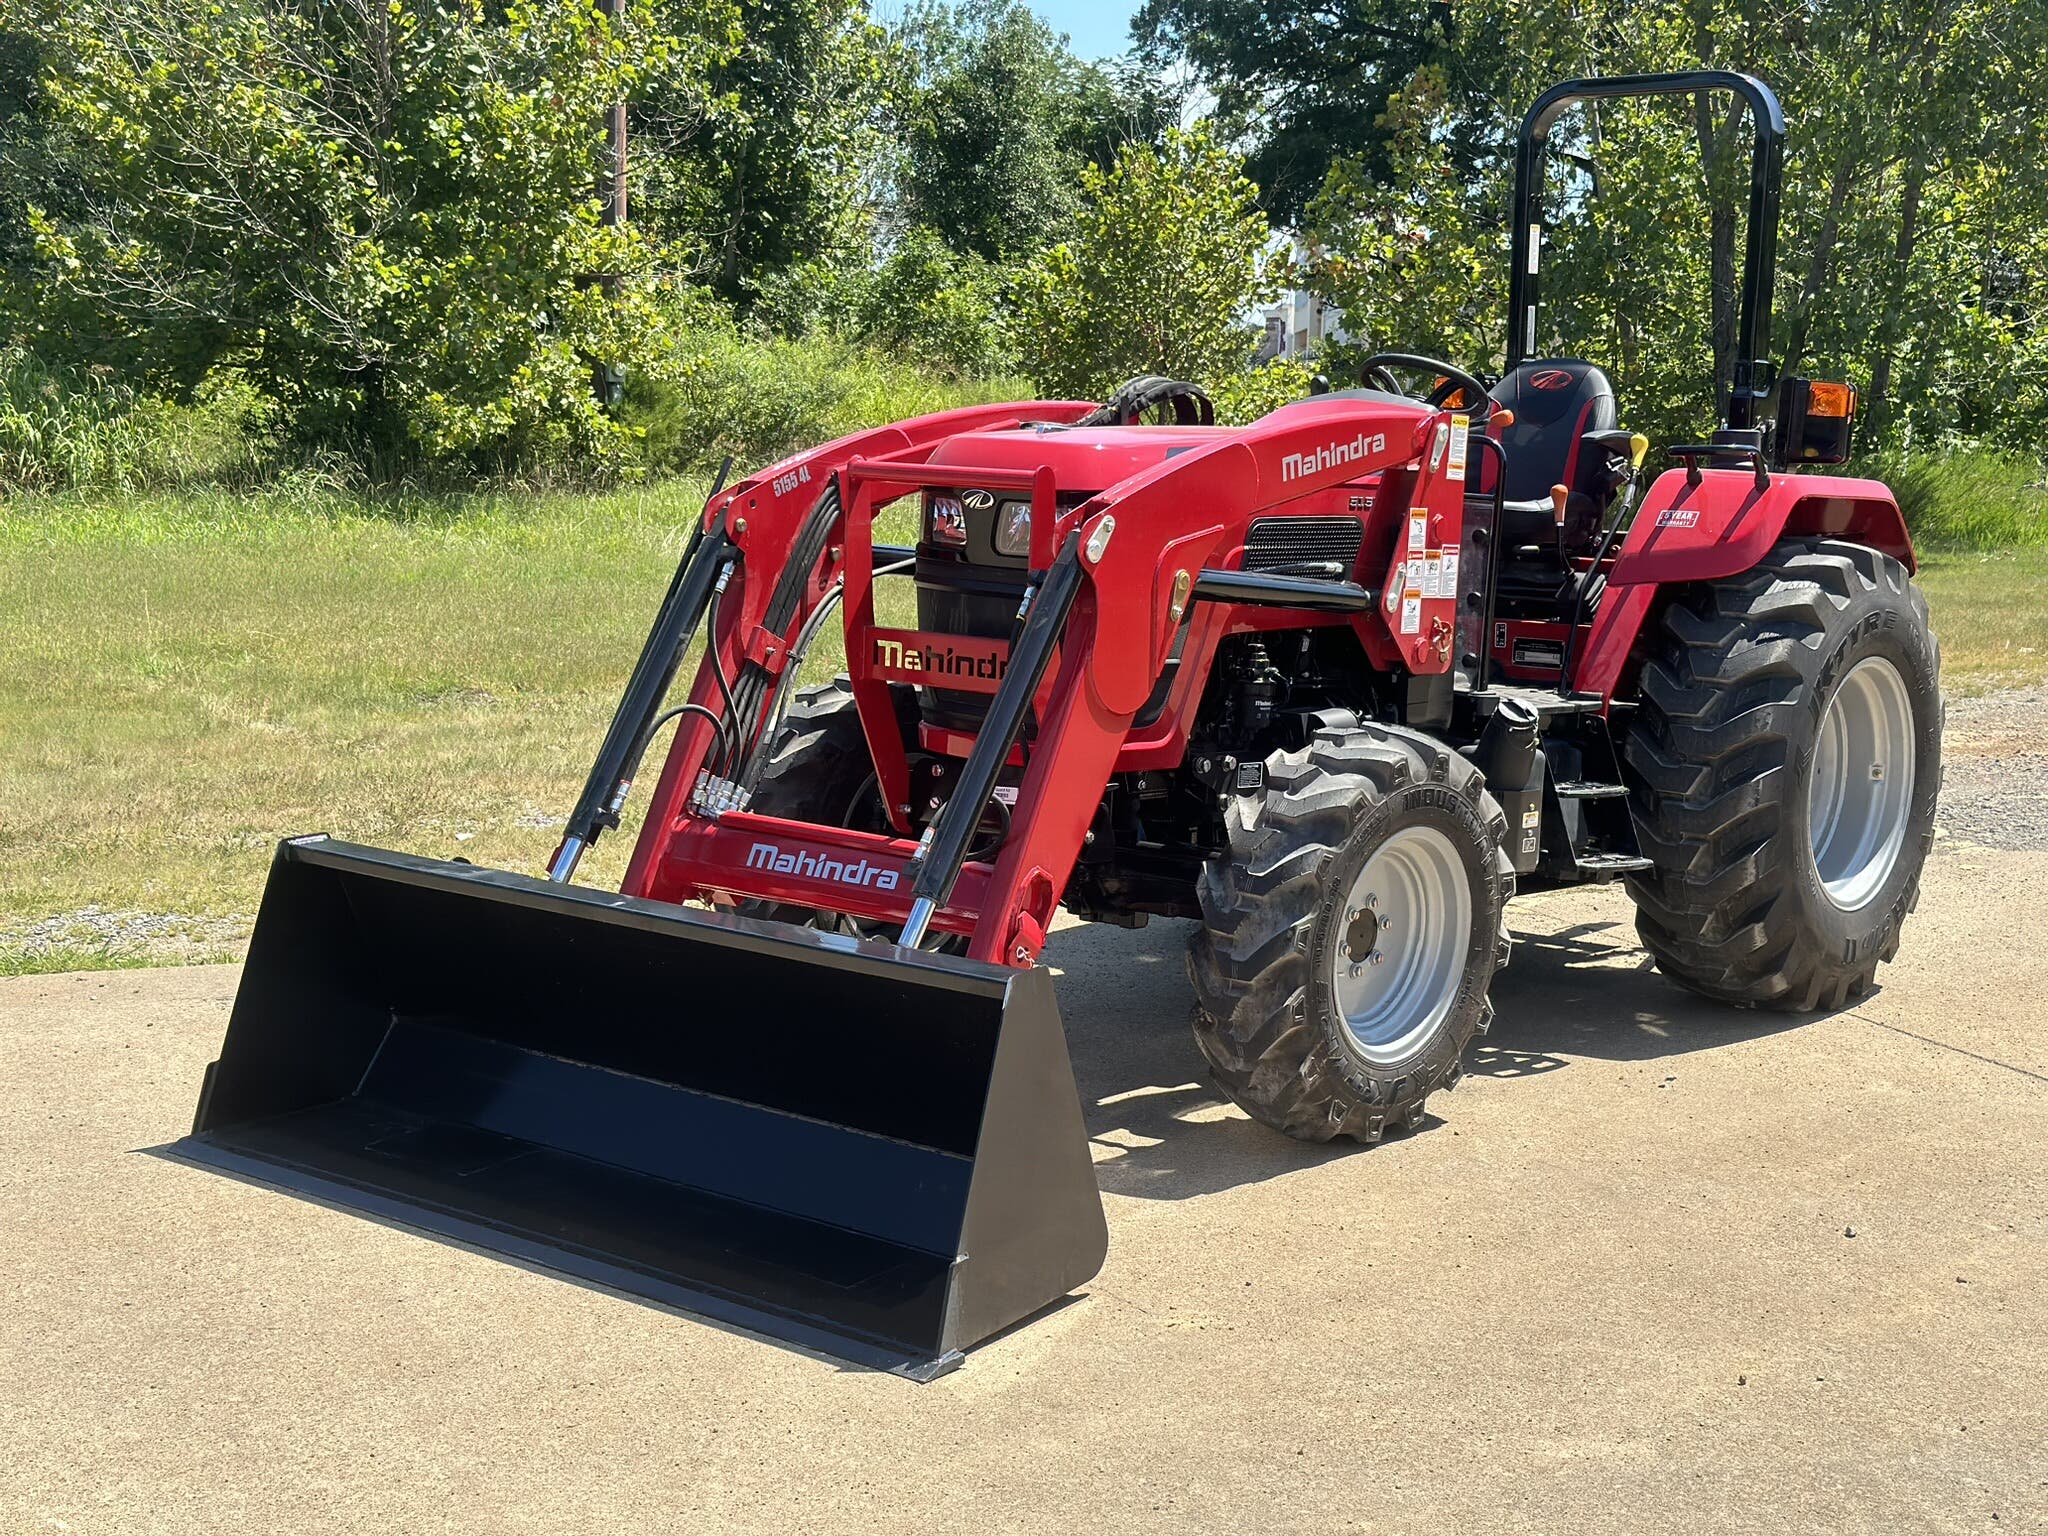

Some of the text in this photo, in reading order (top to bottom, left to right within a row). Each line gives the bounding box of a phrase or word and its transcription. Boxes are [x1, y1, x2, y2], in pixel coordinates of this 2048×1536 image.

[1282, 433, 1385, 482] Mahindra
[772, 471, 799, 498] 5155
[1671, 512, 1694, 520] YEAR
[874, 639, 1009, 681] Mahindr
[746, 843, 899, 890] Mahindra
